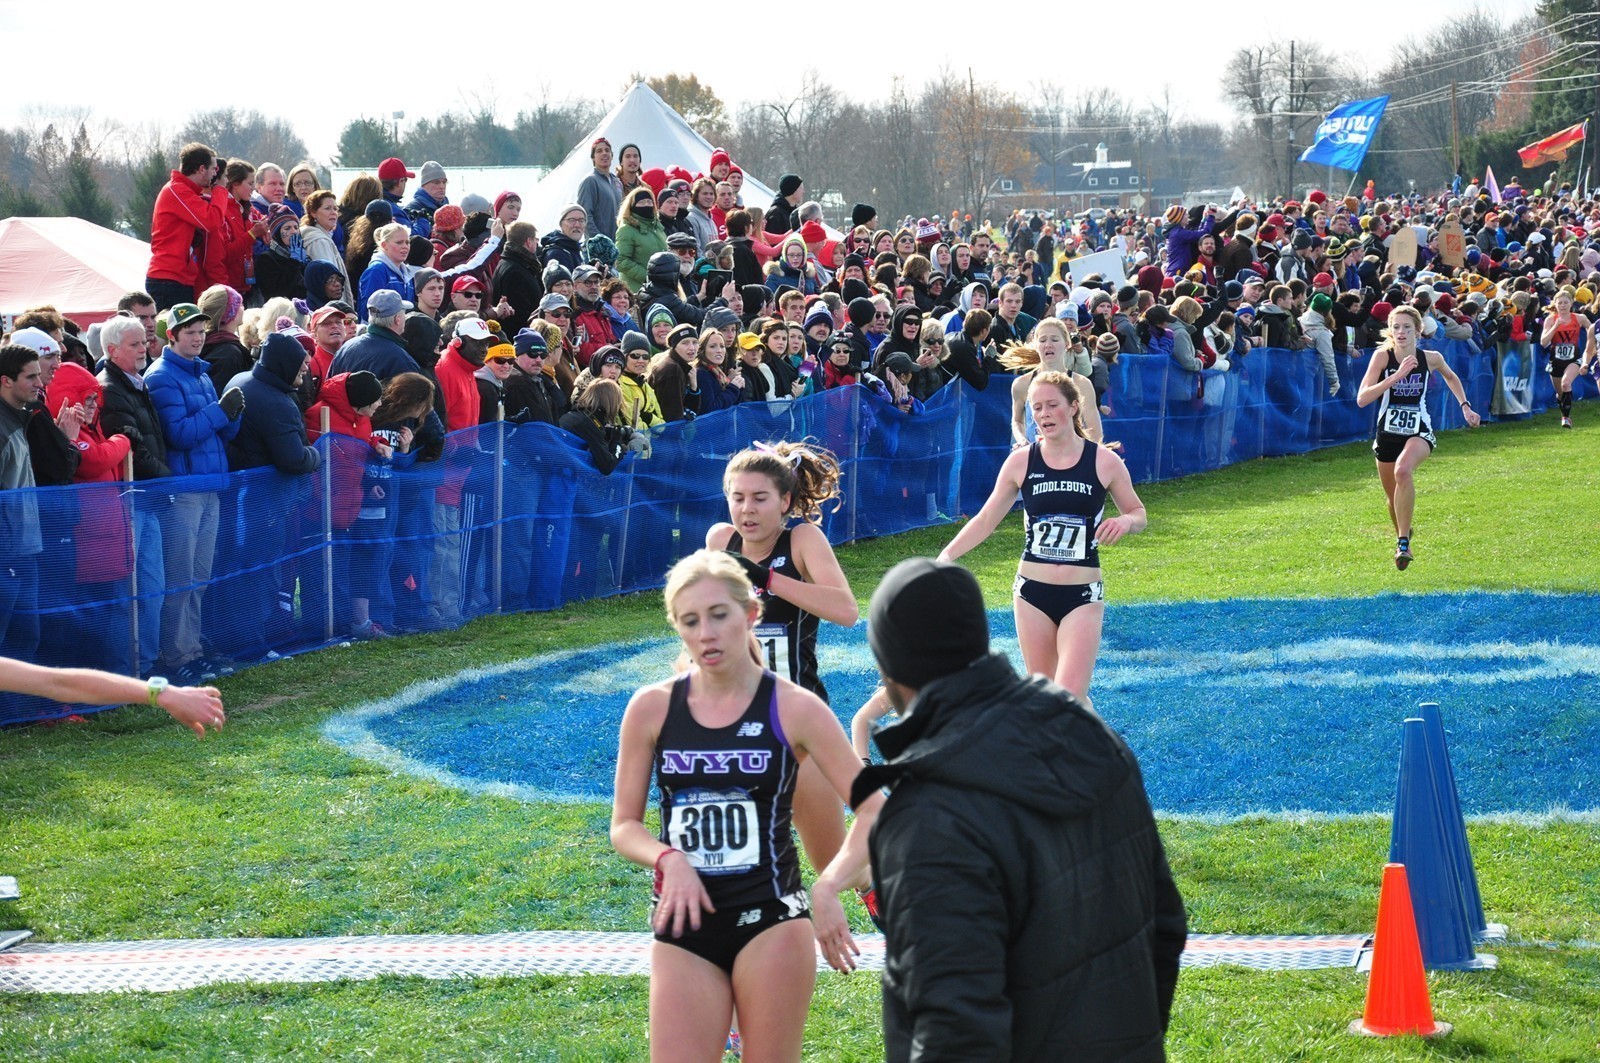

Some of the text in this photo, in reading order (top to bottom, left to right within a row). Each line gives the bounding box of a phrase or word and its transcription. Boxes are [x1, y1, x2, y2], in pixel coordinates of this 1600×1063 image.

[1557, 330, 1577, 343] W
[1557, 346, 1573, 356] 407
[1389, 409, 1417, 429] 295
[1032, 480, 1093, 496] MIDDLEBURY
[1038, 522, 1080, 549] 277
[1040, 548, 1077, 558] MIDDLEBURY
[661, 750, 772, 774] NYU
[679, 803, 748, 853] 300
[704, 852, 724, 866] NYU
